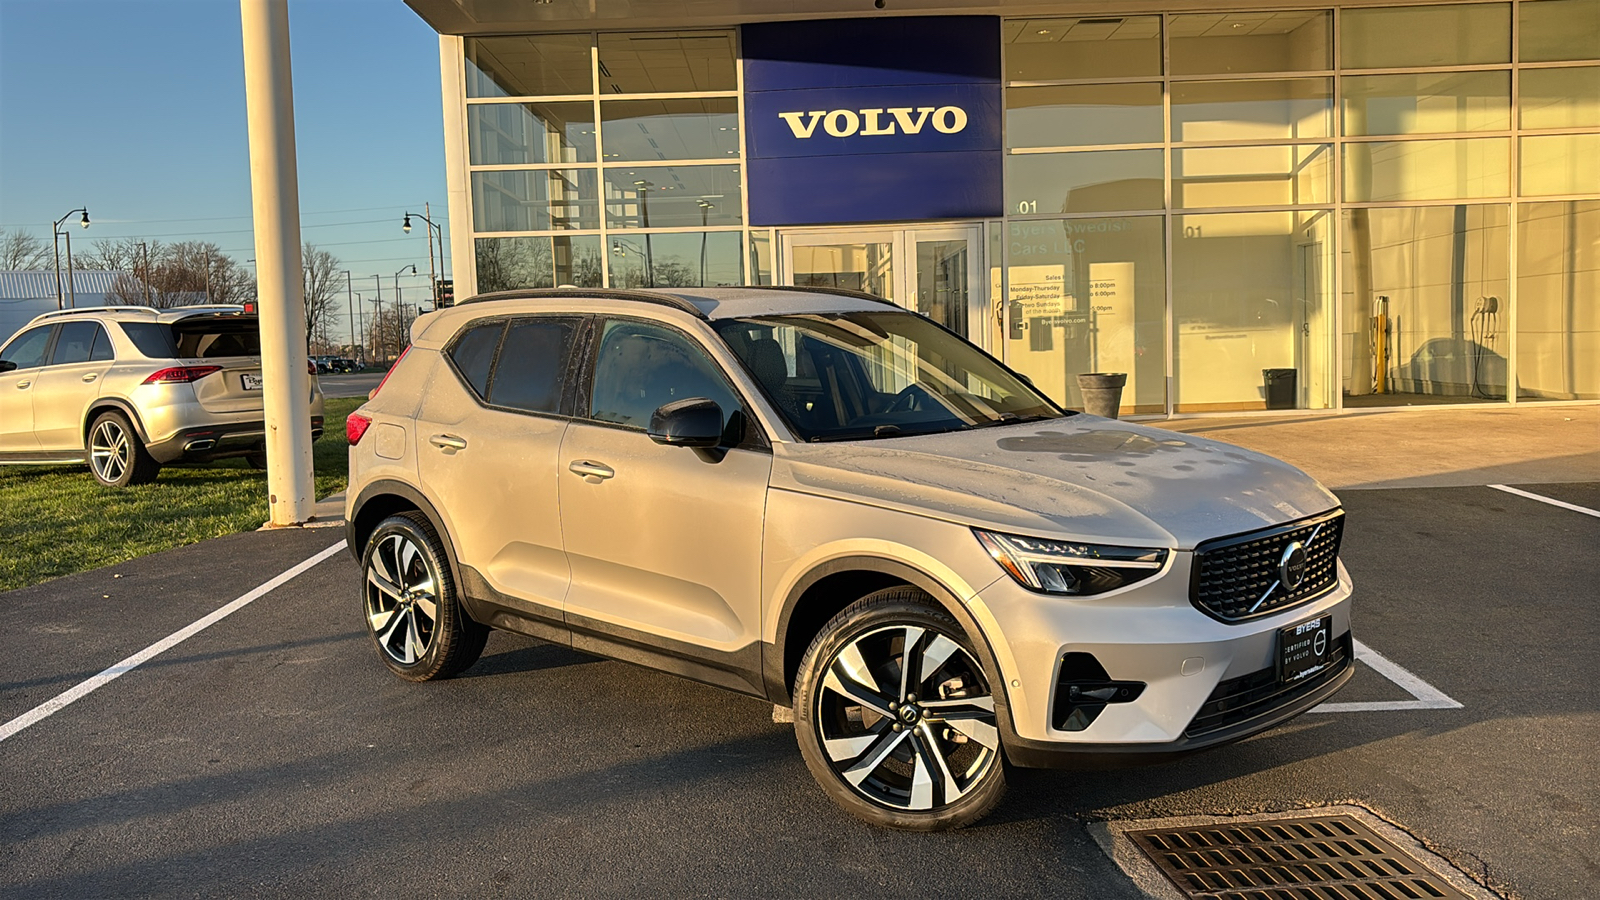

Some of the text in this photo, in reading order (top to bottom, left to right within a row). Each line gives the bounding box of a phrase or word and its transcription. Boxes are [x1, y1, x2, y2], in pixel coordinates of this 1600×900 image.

[778, 106, 968, 139] VOLVO
[1010, 223, 1056, 239] Byers
[1011, 239, 1085, 255] Cars LLC
[1041, 317, 1087, 326] Byesvolvo.com
[1296, 618, 1321, 636] BYERS
[1285, 639, 1310, 653] CERTIFIED
[1285, 650, 1310, 665] BY VOLVO
